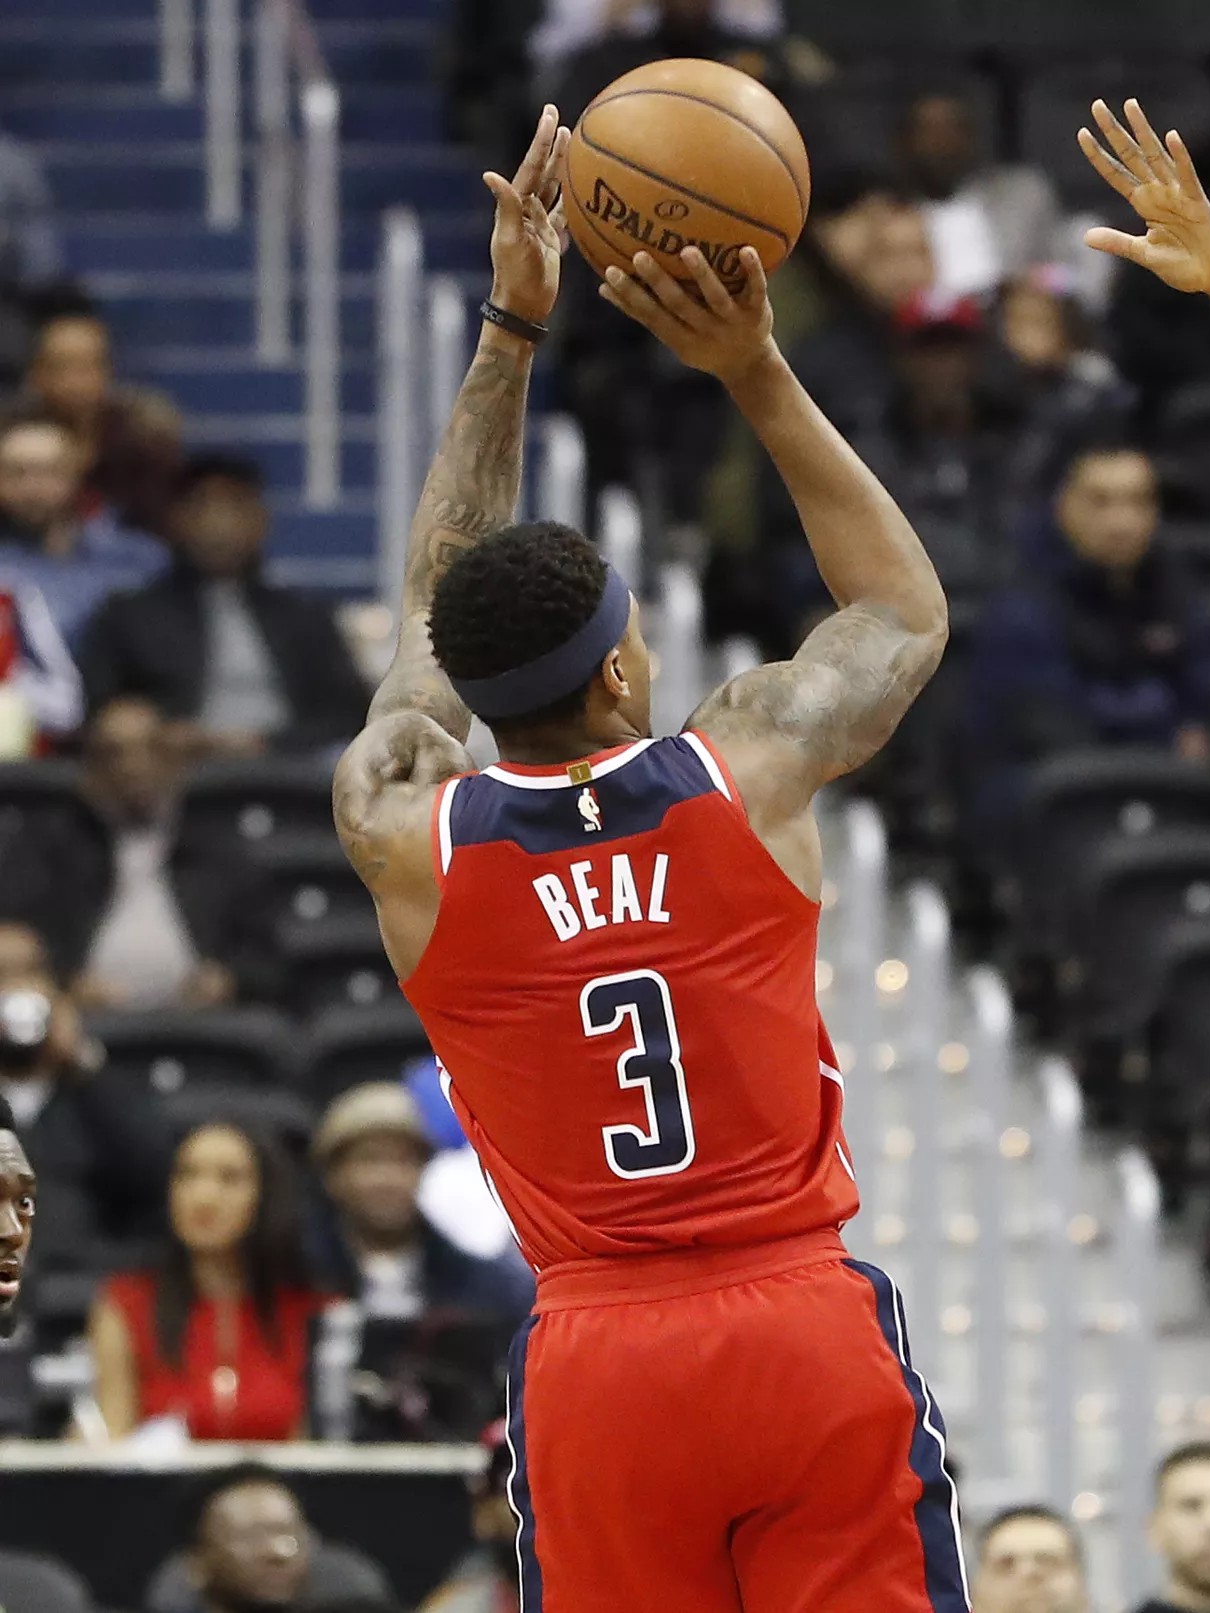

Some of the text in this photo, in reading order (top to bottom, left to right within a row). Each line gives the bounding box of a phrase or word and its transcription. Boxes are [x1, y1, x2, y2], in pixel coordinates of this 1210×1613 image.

[586, 177, 752, 277] SPALDNG
[532, 853, 671, 942] BEAL
[579, 968, 697, 1180] 3
